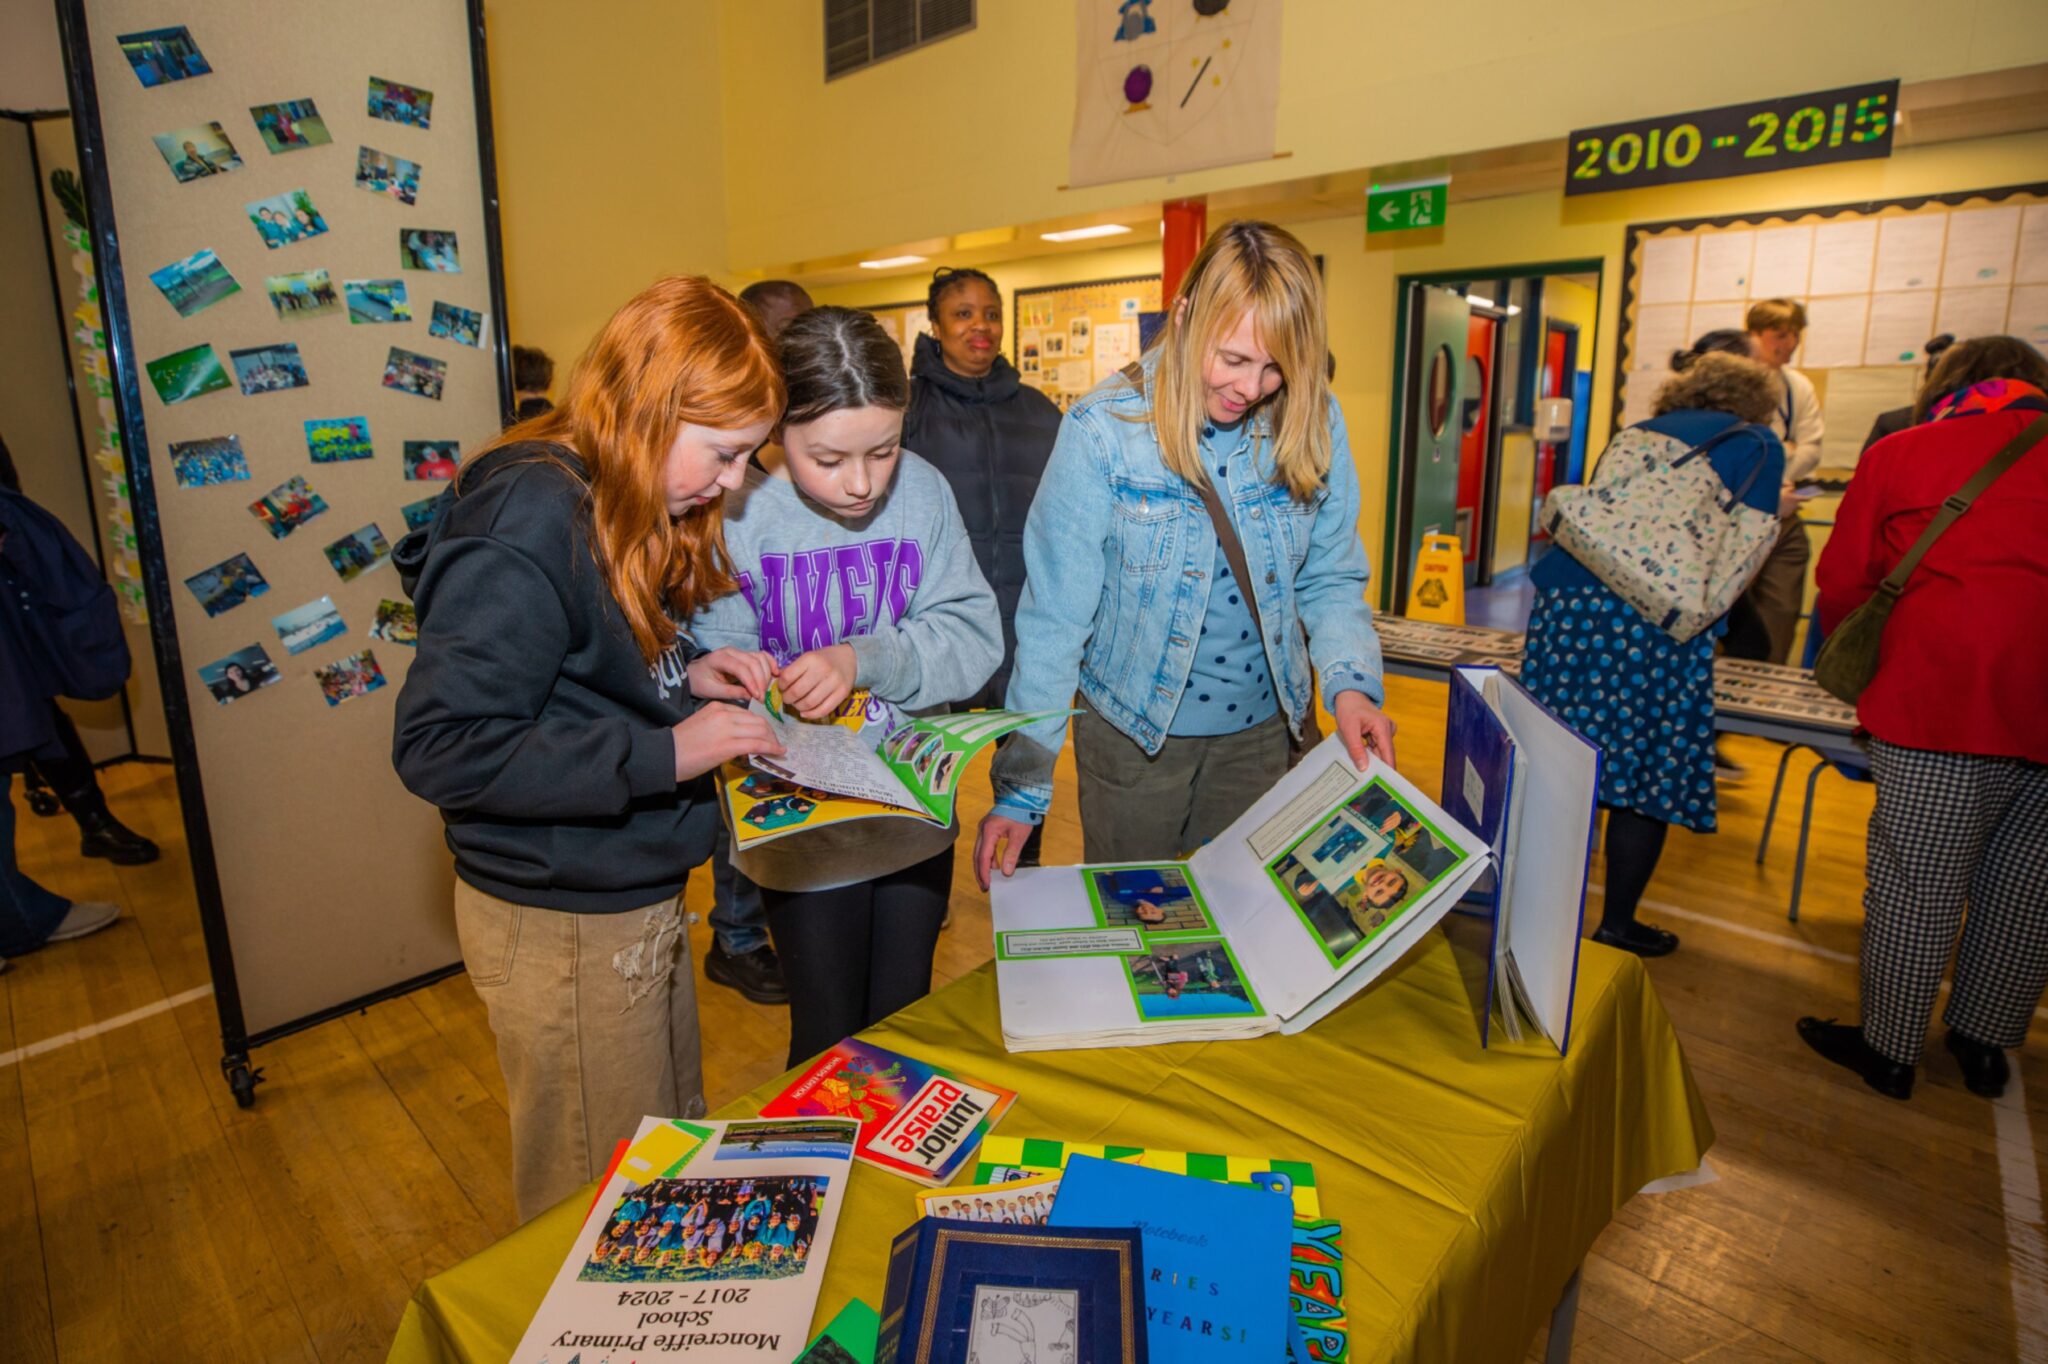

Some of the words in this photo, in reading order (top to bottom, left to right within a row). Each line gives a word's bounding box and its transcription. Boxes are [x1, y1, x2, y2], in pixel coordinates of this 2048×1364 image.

[737, 537, 924, 664] AKES
[890, 1079, 964, 1153] praise
[914, 1093, 984, 1166] Junior
[1133, 1219, 1209, 1247] Notebook
[617, 1290, 674, 1306] 2024
[693, 1288, 751, 1305] 2017
[1290, 1224, 1346, 1364] YEAR
[637, 1310, 713, 1329] School
[551, 1330, 648, 1353] Primary
[653, 1332, 781, 1351] Moncreiffe
